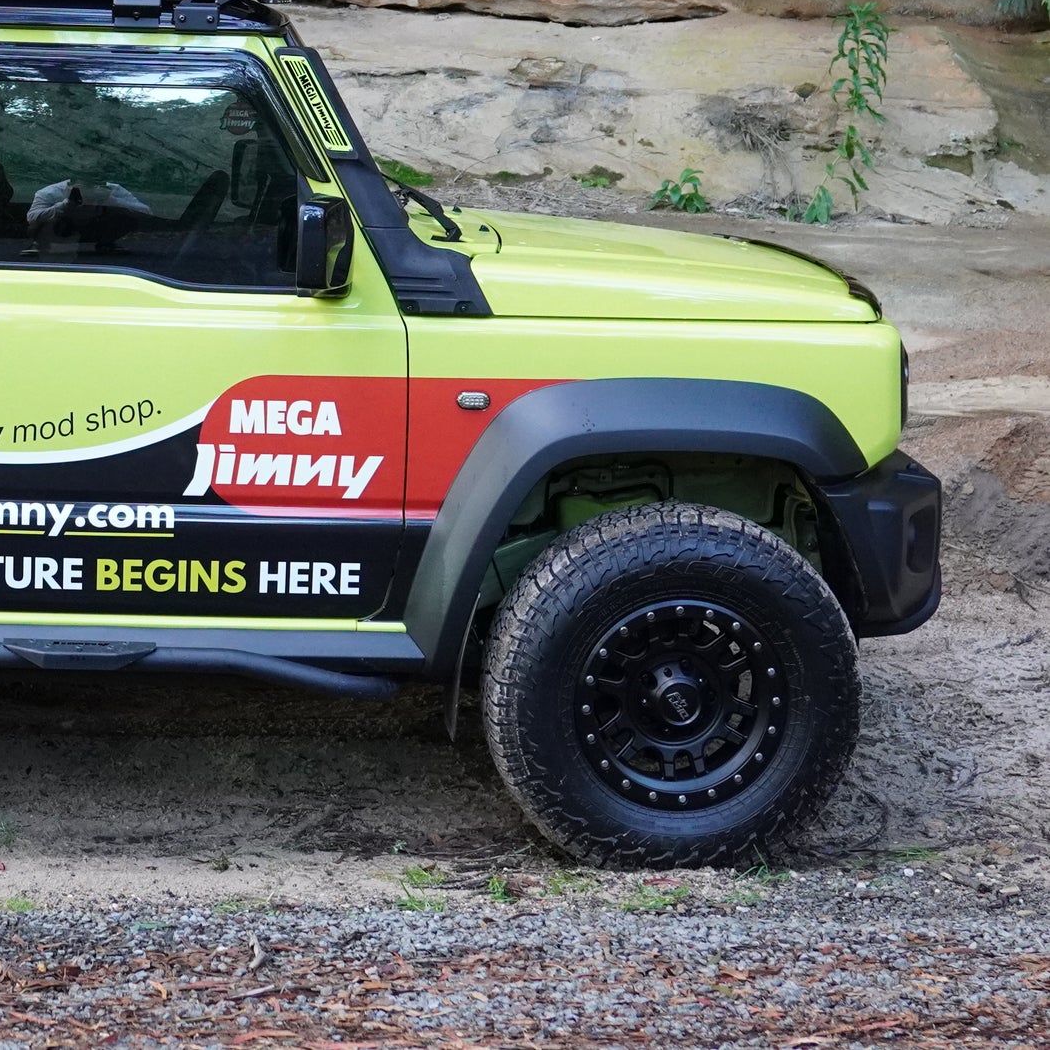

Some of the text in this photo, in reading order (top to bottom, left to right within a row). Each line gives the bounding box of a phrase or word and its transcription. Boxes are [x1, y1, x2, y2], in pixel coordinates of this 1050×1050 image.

[299, 75, 333, 130] MEGA Jimny
[12, 411, 75, 444] mod
[85, 399, 162, 432] shop.
[228, 399, 343, 435] MEGA
[182, 443, 385, 499] Jimny
[96, 558, 247, 594] BEGINS
[258, 560, 361, 595] HERE
